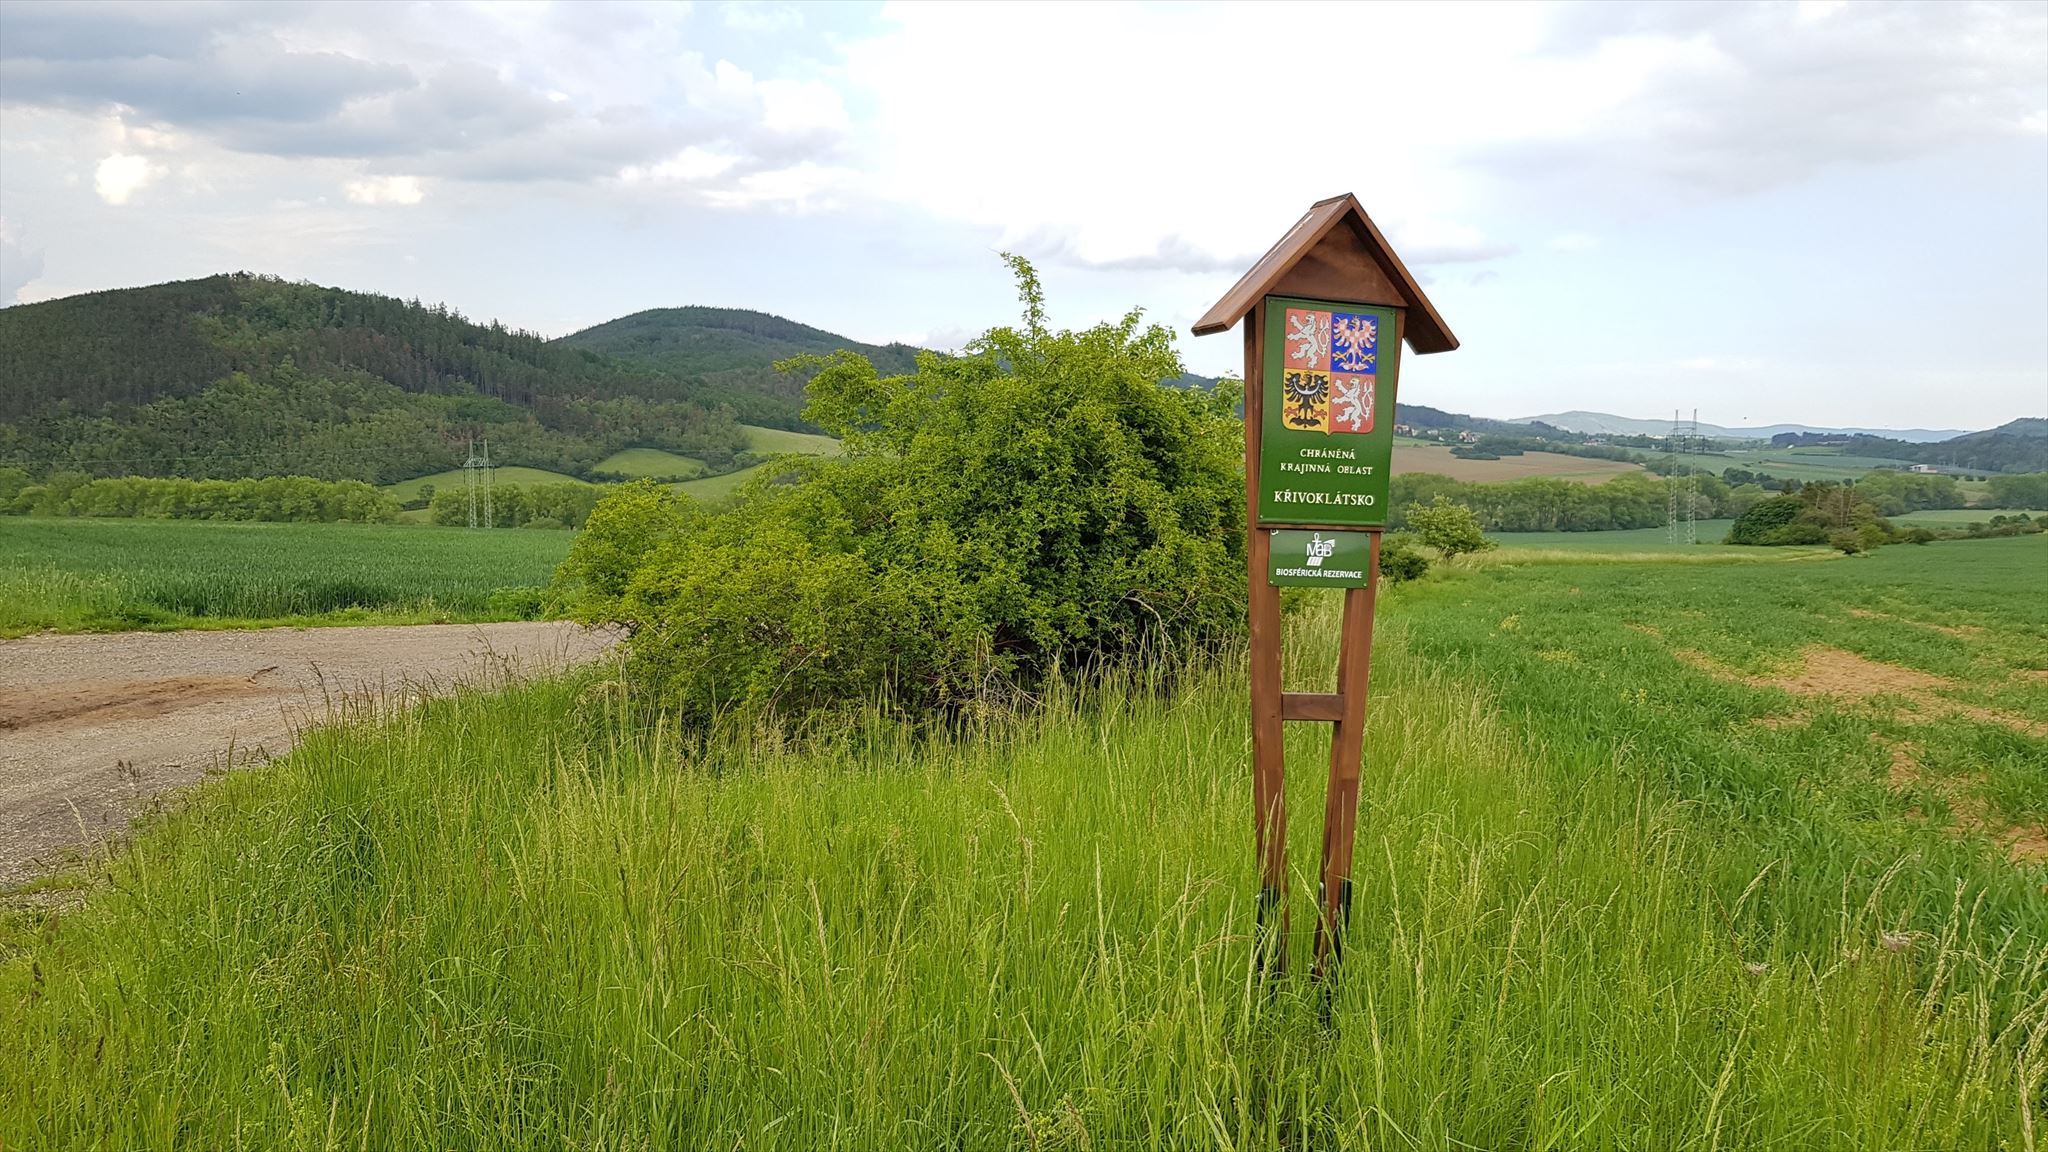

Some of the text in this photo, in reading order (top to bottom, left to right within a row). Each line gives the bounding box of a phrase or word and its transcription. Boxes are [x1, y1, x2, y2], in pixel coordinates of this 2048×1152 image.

[1300, 448, 1355, 460] CHRÁNĚNÁ
[1280, 463, 1373, 475] KRAJINNÁ OBLAST
[1274, 489, 1375, 506] KŘIVOKLÁTSKO
[1275, 568, 1362, 579] BIOSFÉRICKÁ REZERVACE
